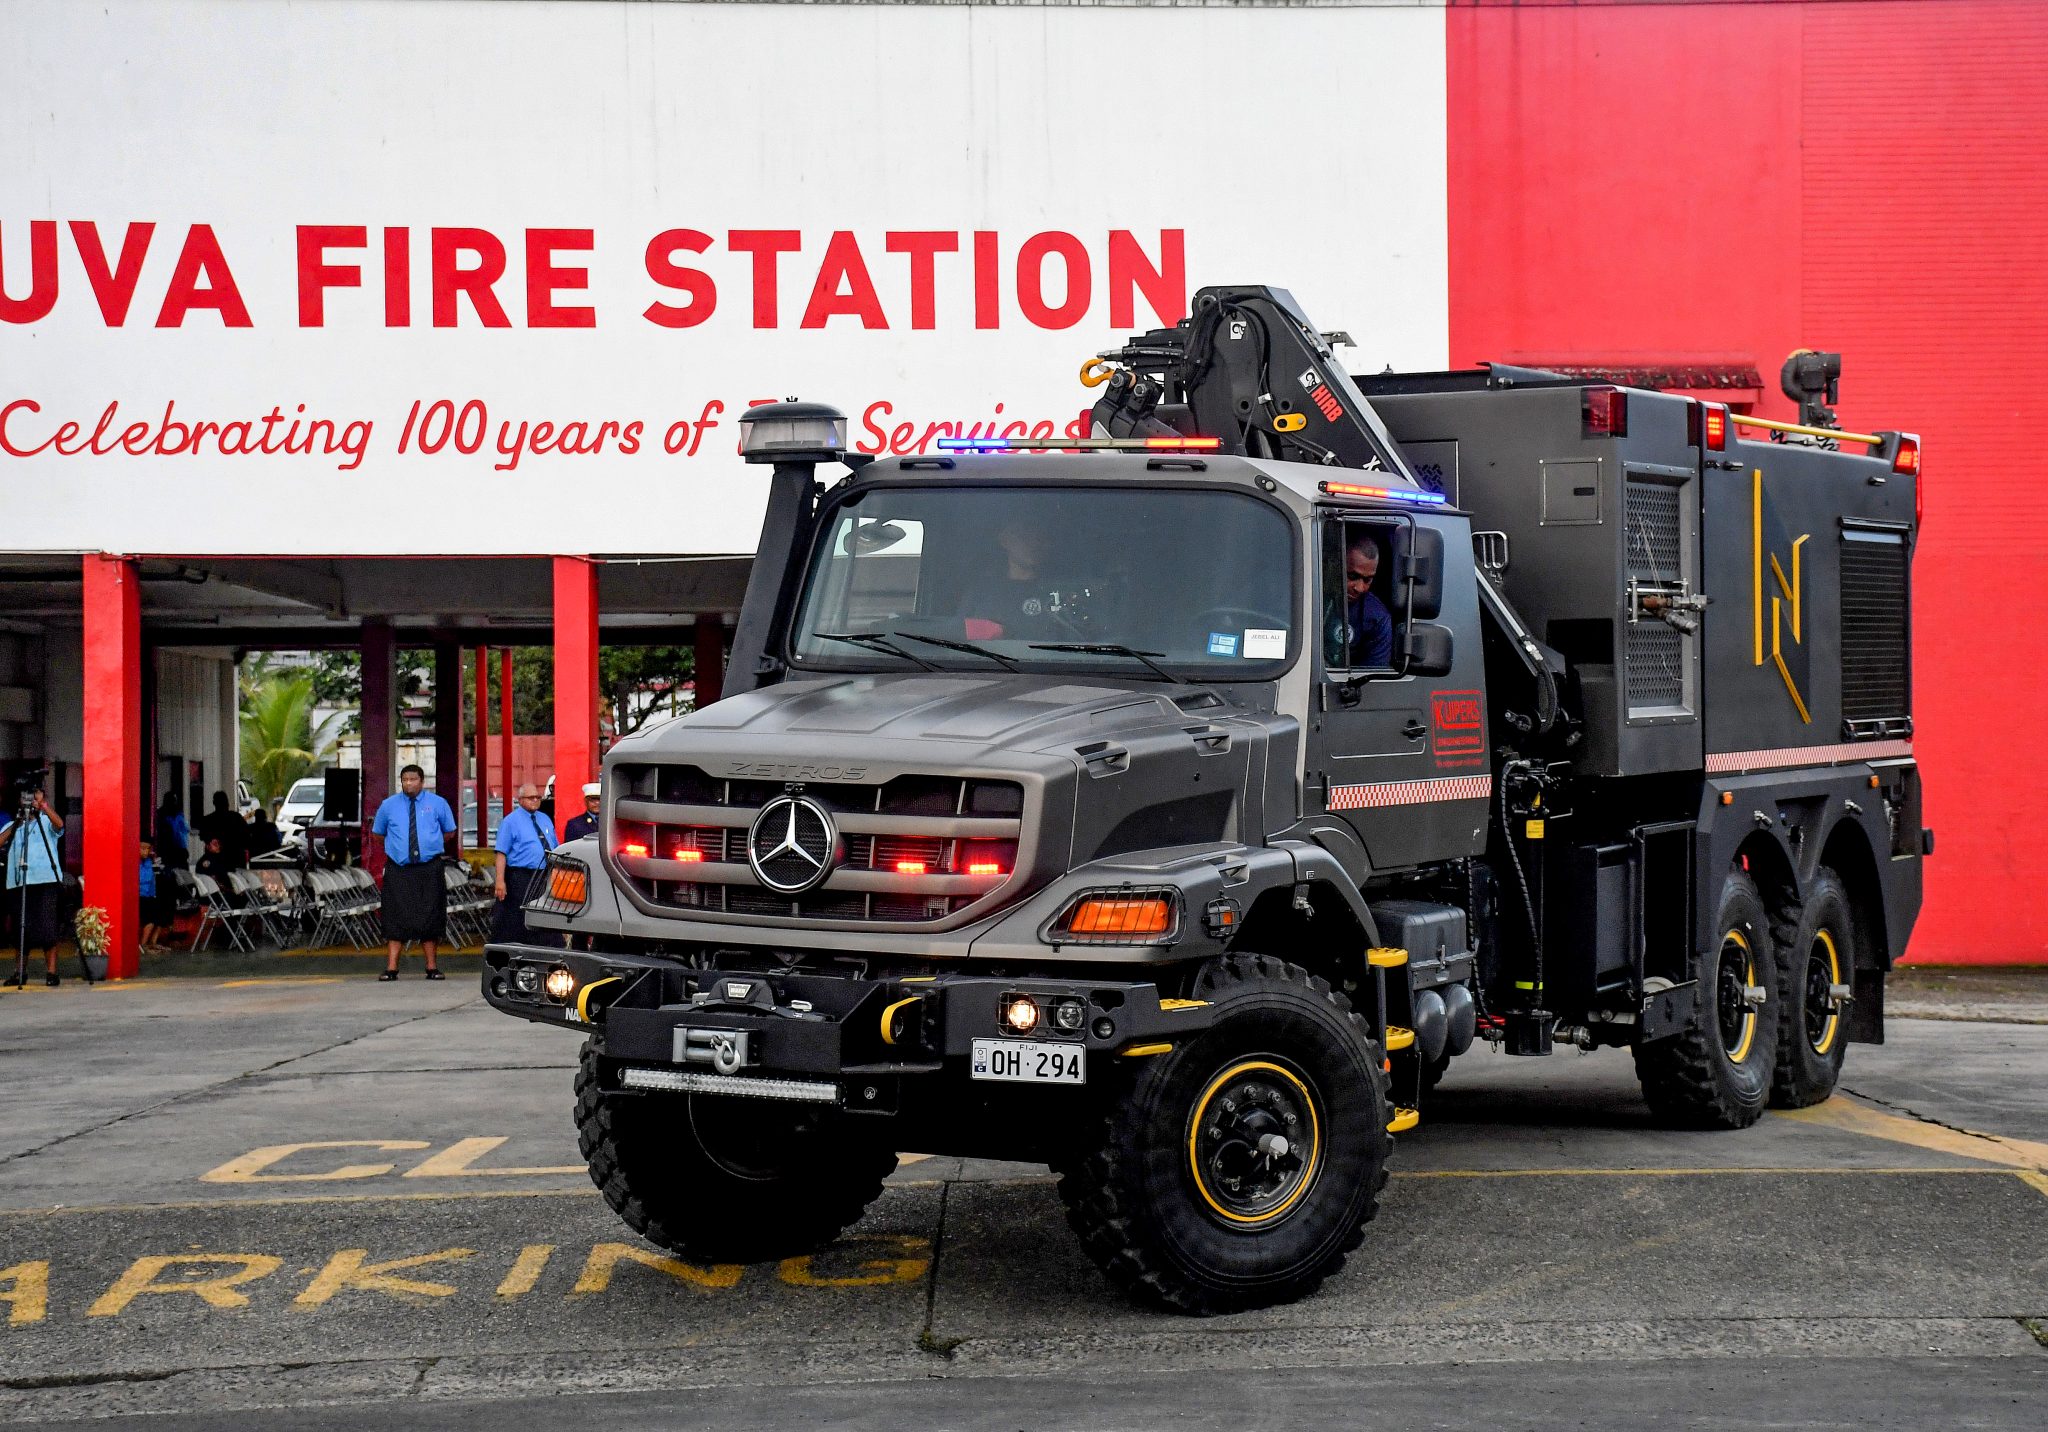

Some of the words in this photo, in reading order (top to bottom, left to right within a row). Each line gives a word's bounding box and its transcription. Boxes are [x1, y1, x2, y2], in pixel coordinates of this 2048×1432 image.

[0, 219, 254, 329] UVA
[295, 224, 597, 329] FIRE
[642, 228, 1188, 331] STATION
[1311, 384, 1344, 424] HIAB
[0, 399, 374, 471] Celebrating
[397, 399, 488, 455] 100
[494, 420, 645, 471] years
[663, 399, 725, 457] of
[727, 762, 868, 780] ZETROS
[565, 1007, 582, 1022] NA
[1019, 1043, 1038, 1051] FIJI
[199, 1135, 600, 1184] CL
